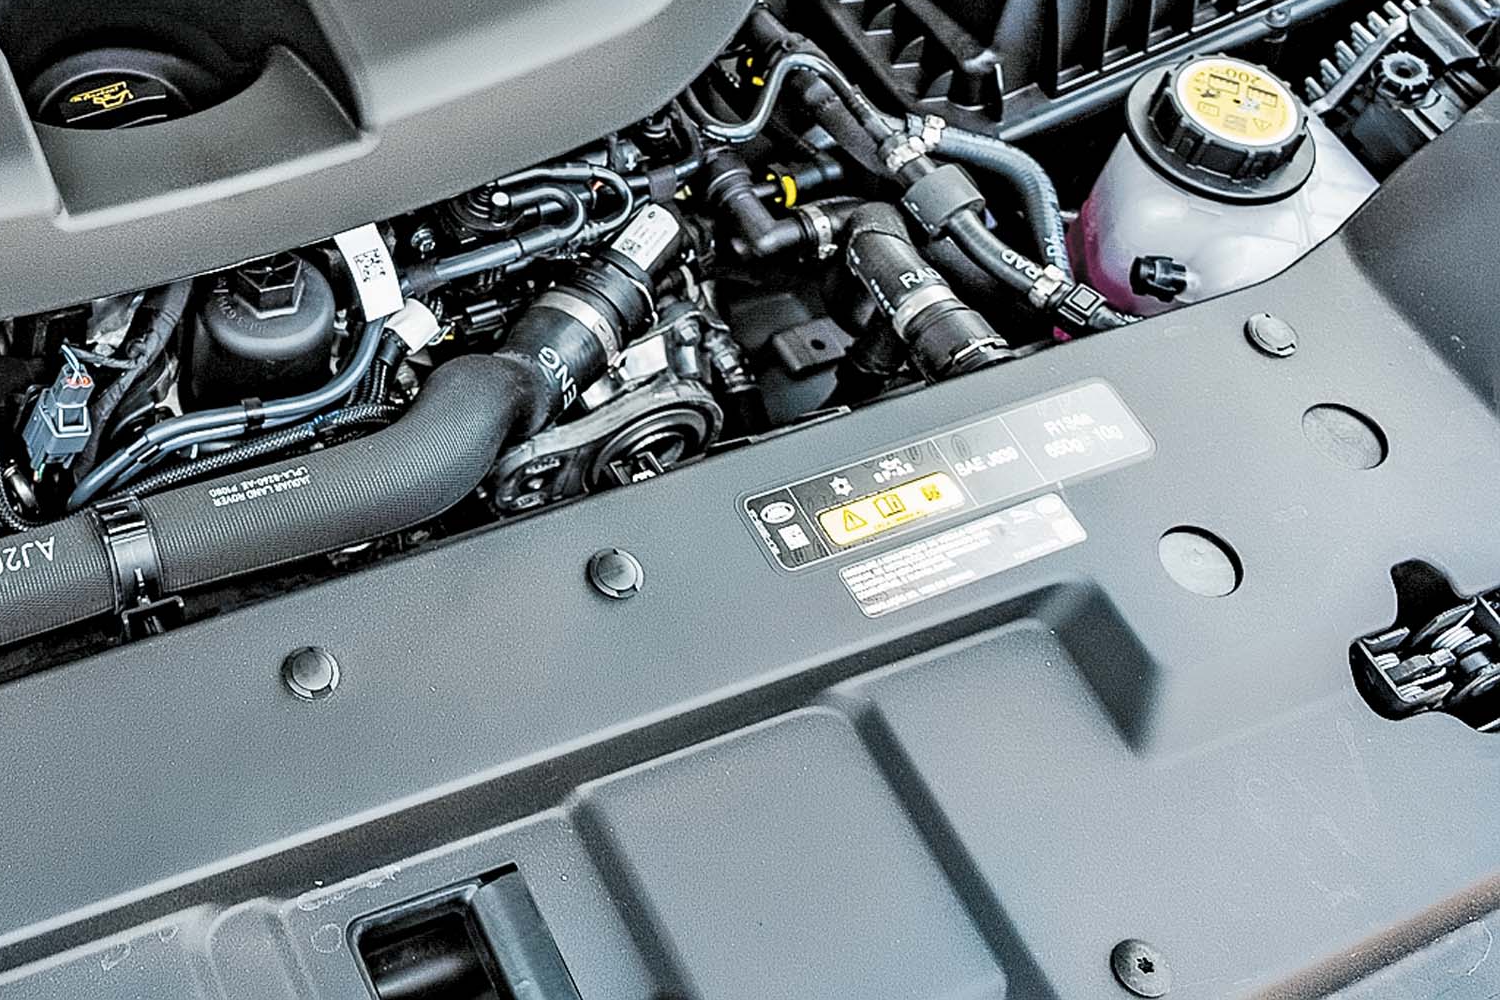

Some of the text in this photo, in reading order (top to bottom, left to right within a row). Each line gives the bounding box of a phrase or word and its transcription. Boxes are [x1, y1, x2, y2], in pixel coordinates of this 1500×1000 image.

[899, 266, 941, 289] RAD
[212, 474, 311, 507] JAGUAR LAND ROVER
